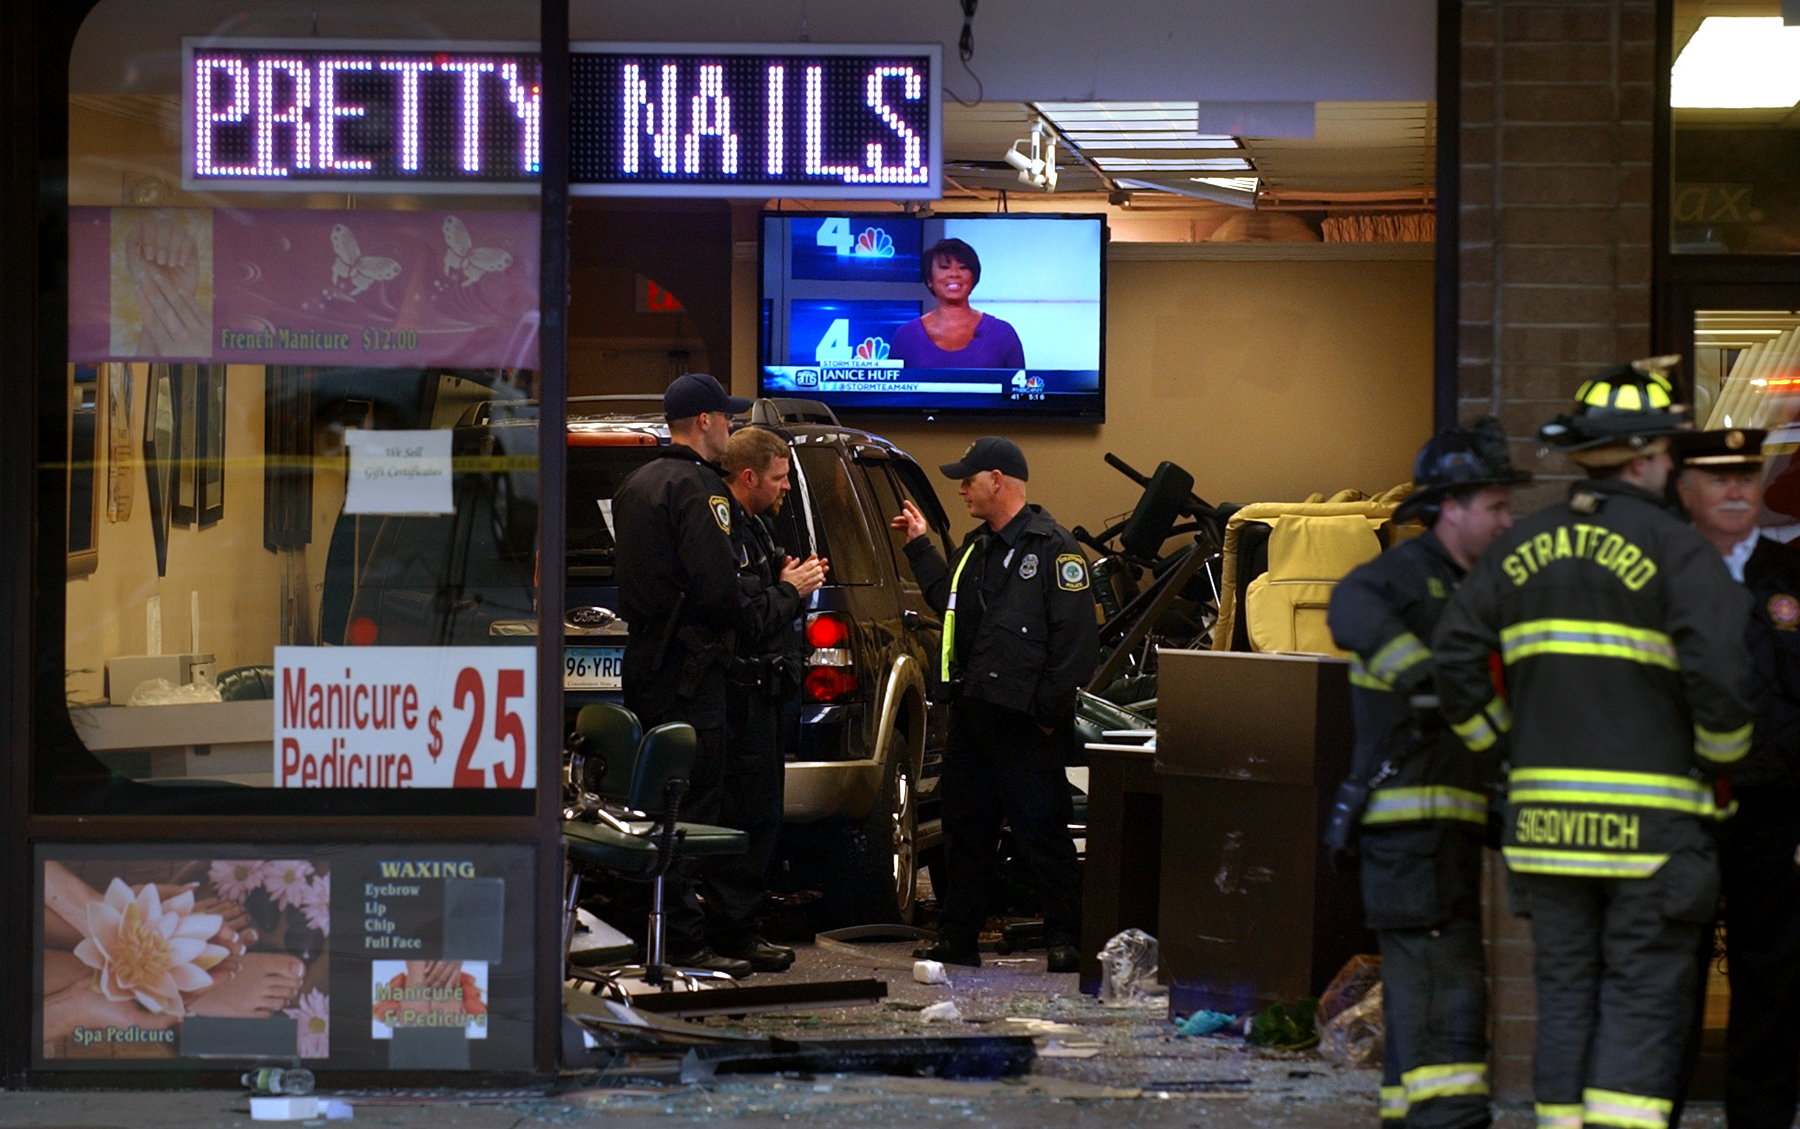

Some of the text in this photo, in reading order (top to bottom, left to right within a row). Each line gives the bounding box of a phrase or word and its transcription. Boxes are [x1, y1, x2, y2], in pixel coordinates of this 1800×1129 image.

[196, 59, 929, 184] PRETTY NAILS
[816, 217, 855, 256] 4
[221, 327, 418, 351] French Manicure $12.00
[815, 318, 854, 362] 4
[823, 360, 880, 368] STORM TEAM 4
[822, 369, 900, 382] JANICE HUFF
[1011, 370, 1027, 388] 4
[838, 383, 919, 392] @STORMTEAM4NY
[385, 446, 424, 458] We Sell
[364, 466, 443, 480] Gift Certificates
[1502, 523, 1658, 592] STRATFORD
[573, 610, 604, 622] Ford
[282, 667, 419, 731] Manicure
[281, 737, 413, 788] Pedicure
[1516, 808, 1639, 849] SIGOVITCH
[380, 861, 476, 879] WAXING
[365, 883, 420, 899] Eyebrow
[365, 901, 387, 916] Lip
[365, 918, 396, 934] Chip
[365, 936, 423, 949] Full Face
[375, 982, 465, 1001] Manicure
[384, 1008, 487, 1028] & Pedicure
[73, 1026, 176, 1047] Spa Pedicure
